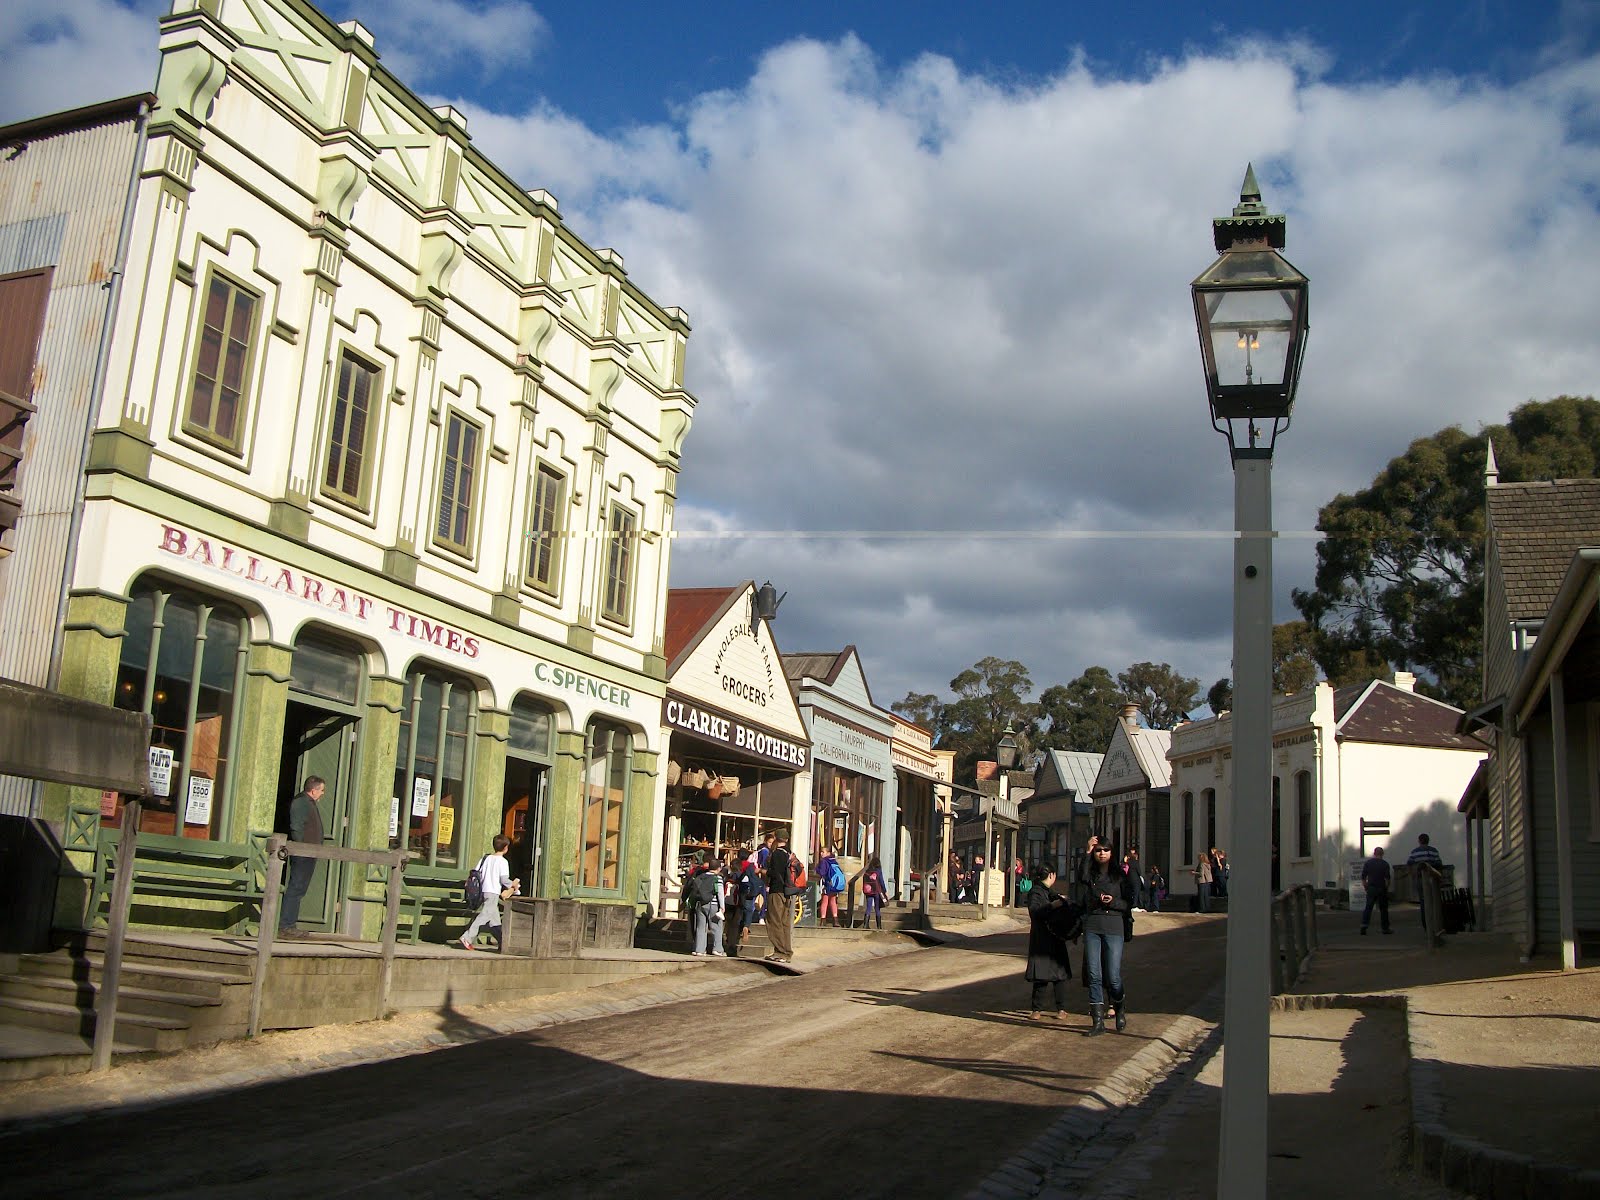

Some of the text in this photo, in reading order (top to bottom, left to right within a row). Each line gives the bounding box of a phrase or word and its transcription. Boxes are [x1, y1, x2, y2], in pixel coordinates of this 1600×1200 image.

[158, 524, 481, 659] BALLARAT TIMES
[714, 624, 752, 675] WHOLESALE
[761, 645, 775, 700] FAMILY
[722, 675, 767, 707] GROCERS
[666, 700, 806, 767] CLARKE BROTHERS
[864, 758, 882, 773] MAKER
